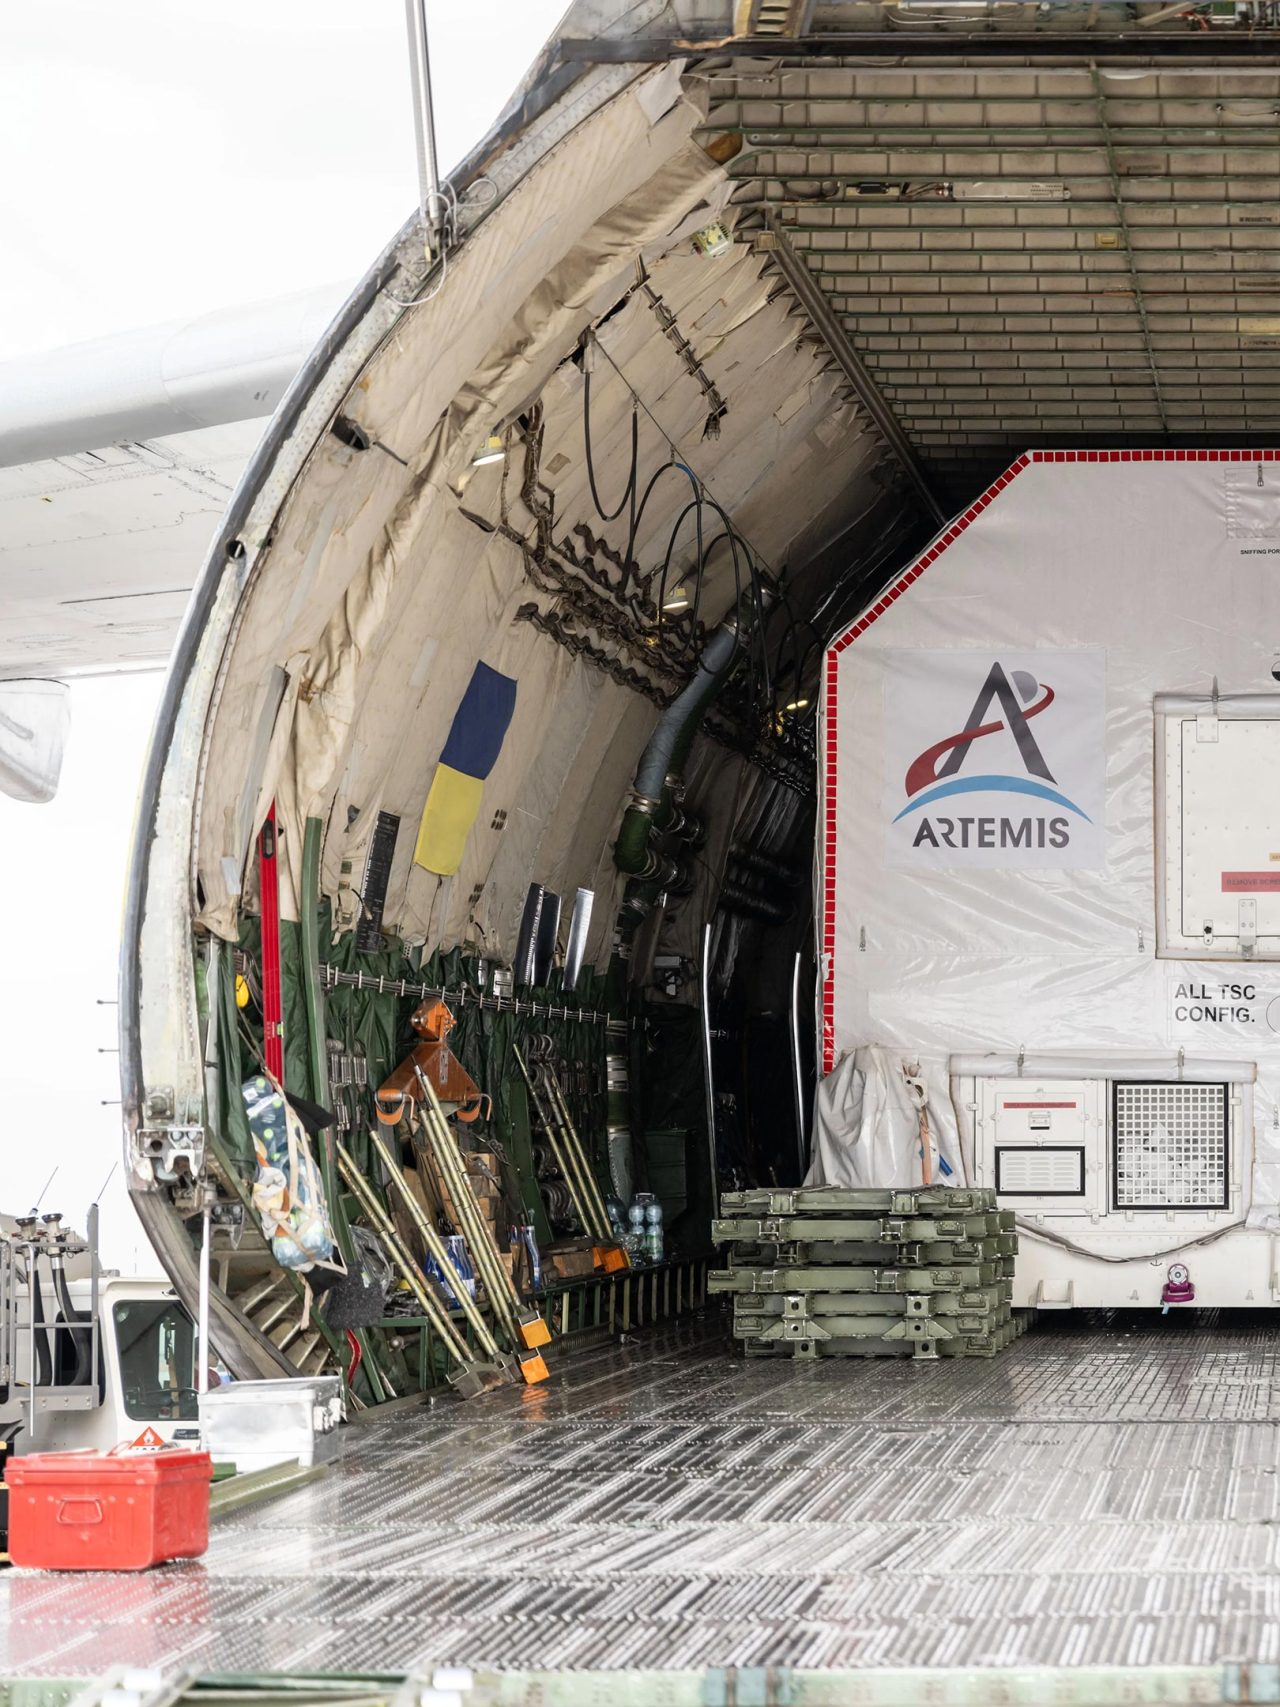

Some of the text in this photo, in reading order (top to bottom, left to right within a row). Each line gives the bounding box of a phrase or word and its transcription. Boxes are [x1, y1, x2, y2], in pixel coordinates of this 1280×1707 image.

[912, 817, 1070, 849] ARTEMIS
[1174, 984, 1256, 1000] ALL TSC
[1174, 1006, 1255, 1022] CONFIG.
